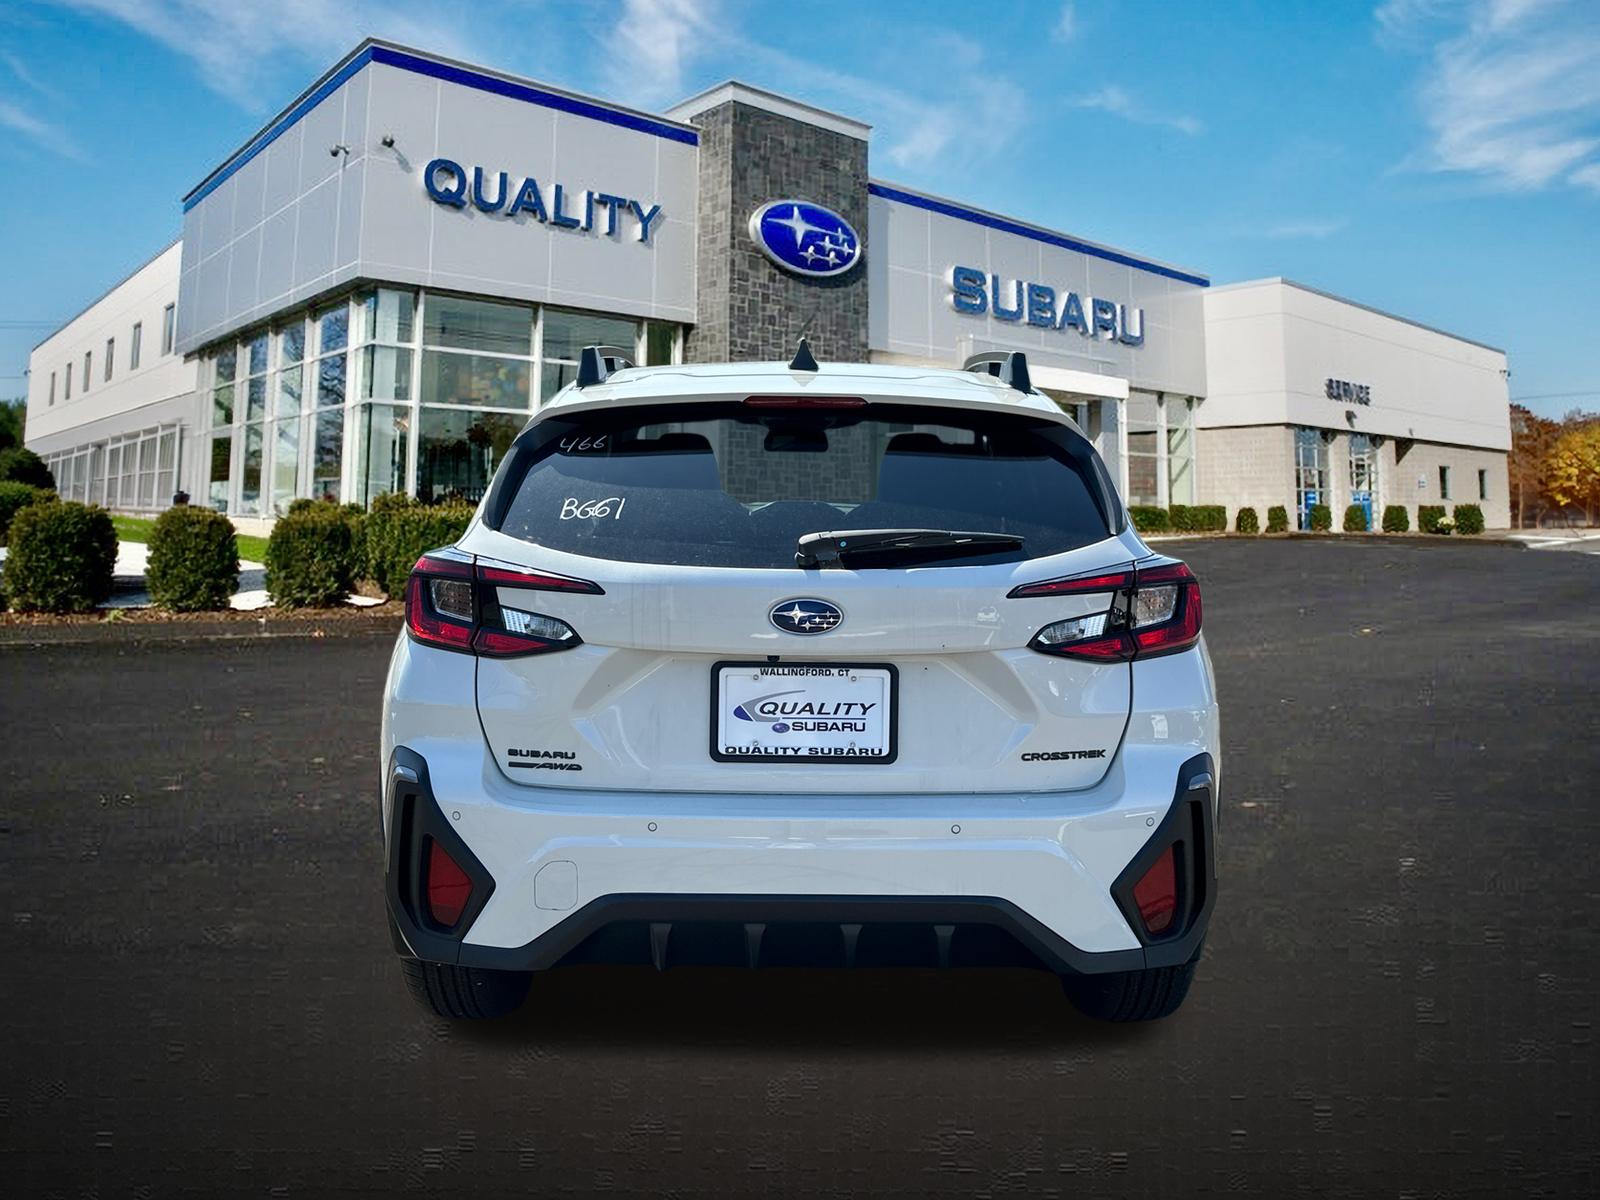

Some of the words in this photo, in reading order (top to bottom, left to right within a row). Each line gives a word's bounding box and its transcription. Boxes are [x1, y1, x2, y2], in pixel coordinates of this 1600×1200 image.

[424, 158, 662, 243] QUALITY
[950, 265, 1145, 347] SUBARU
[1324, 378, 1371, 407] SERVICE
[560, 435, 607, 452] 466
[838, 668, 850, 677] CT
[759, 702, 876, 715] QUALITY
[792, 721, 866, 733] SUBARU
[508, 748, 576, 759] SUBARU
[725, 746, 801, 755] QUALITY
[808, 747, 883, 756] SUBARU
[1021, 749, 1106, 761] CROSSTREK
[536, 762, 583, 771] AWD
